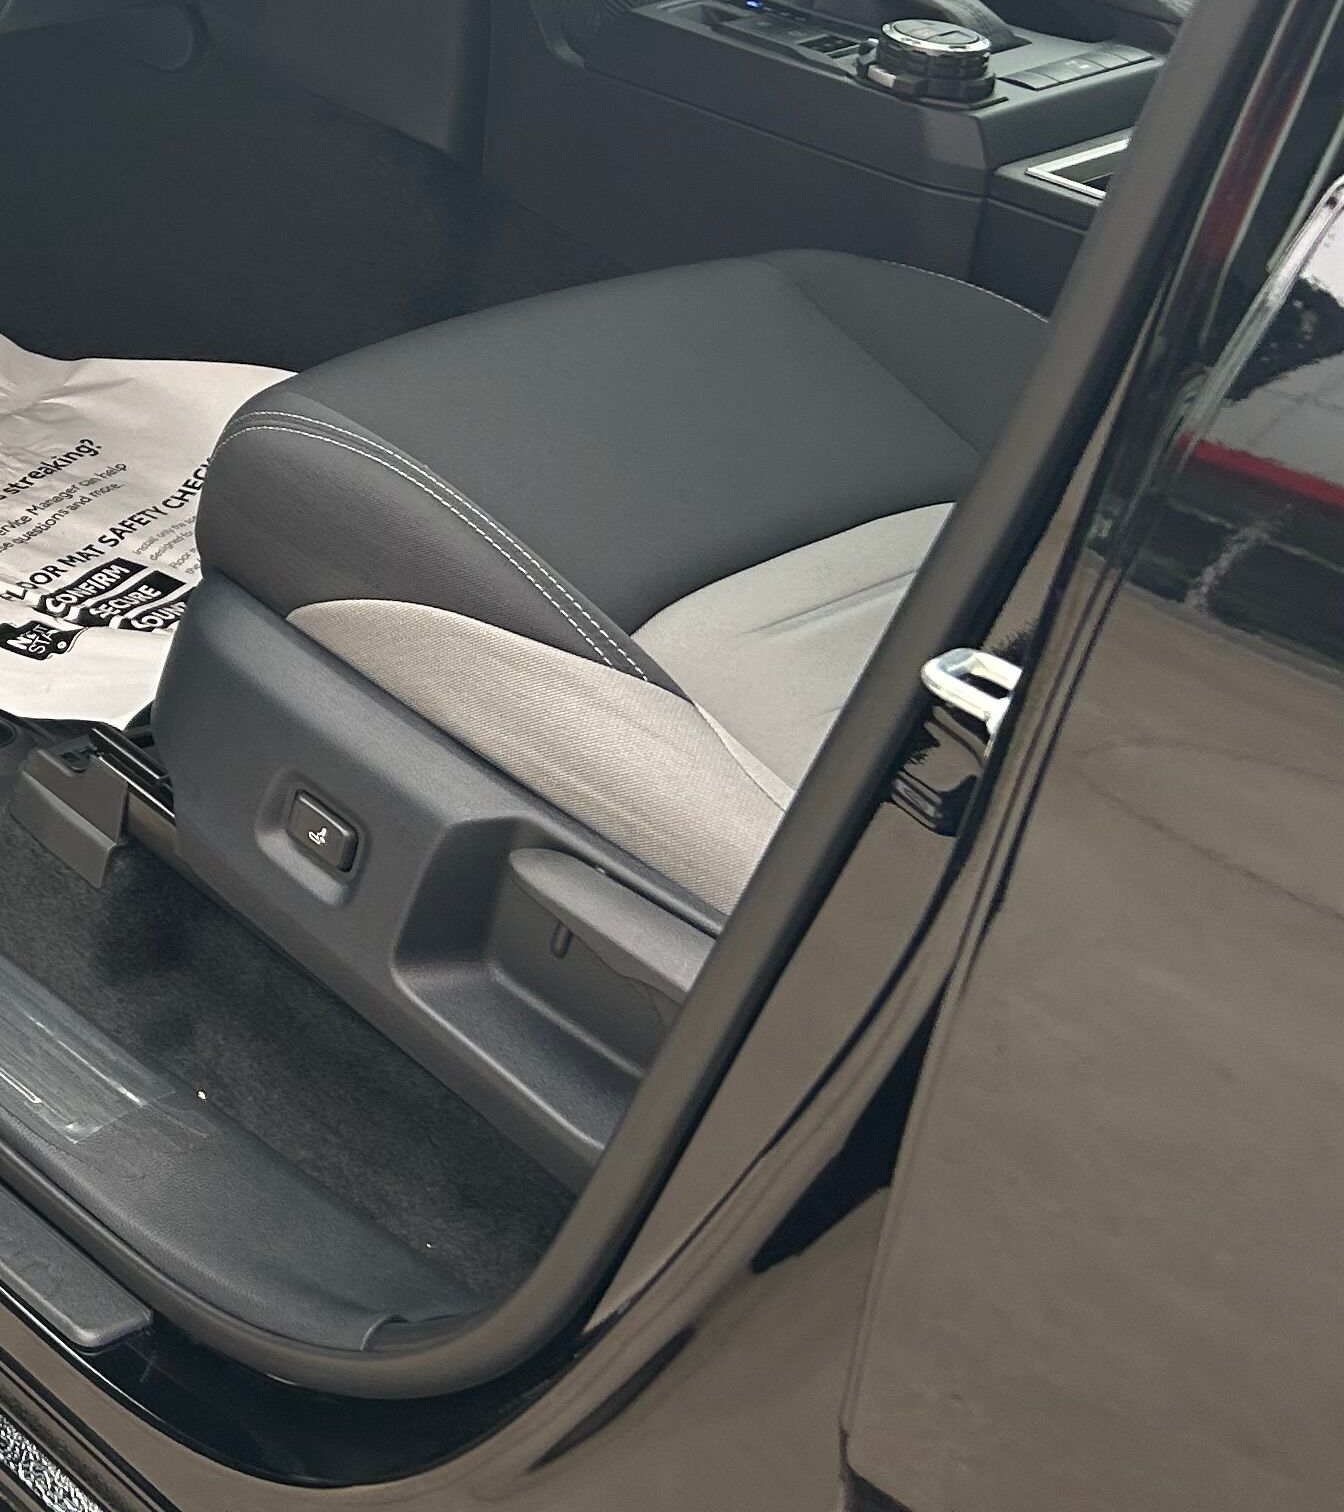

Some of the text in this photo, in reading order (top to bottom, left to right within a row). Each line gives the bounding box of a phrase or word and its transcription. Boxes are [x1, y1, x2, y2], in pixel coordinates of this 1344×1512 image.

[2, 438, 103, 495] streaking?
[25, 483, 81, 516] Manager
[78, 472, 100, 488] can
[94, 462, 127, 479] help
[12, 508, 71, 545] questions
[65, 495, 92, 512] and
[57, 543, 109, 568] MAT
[97, 505, 169, 548] SAFETY
[44, 563, 131, 614] CONFIRM
[89, 583, 162, 619] SECURE
[131, 601, 187, 629] COUN
